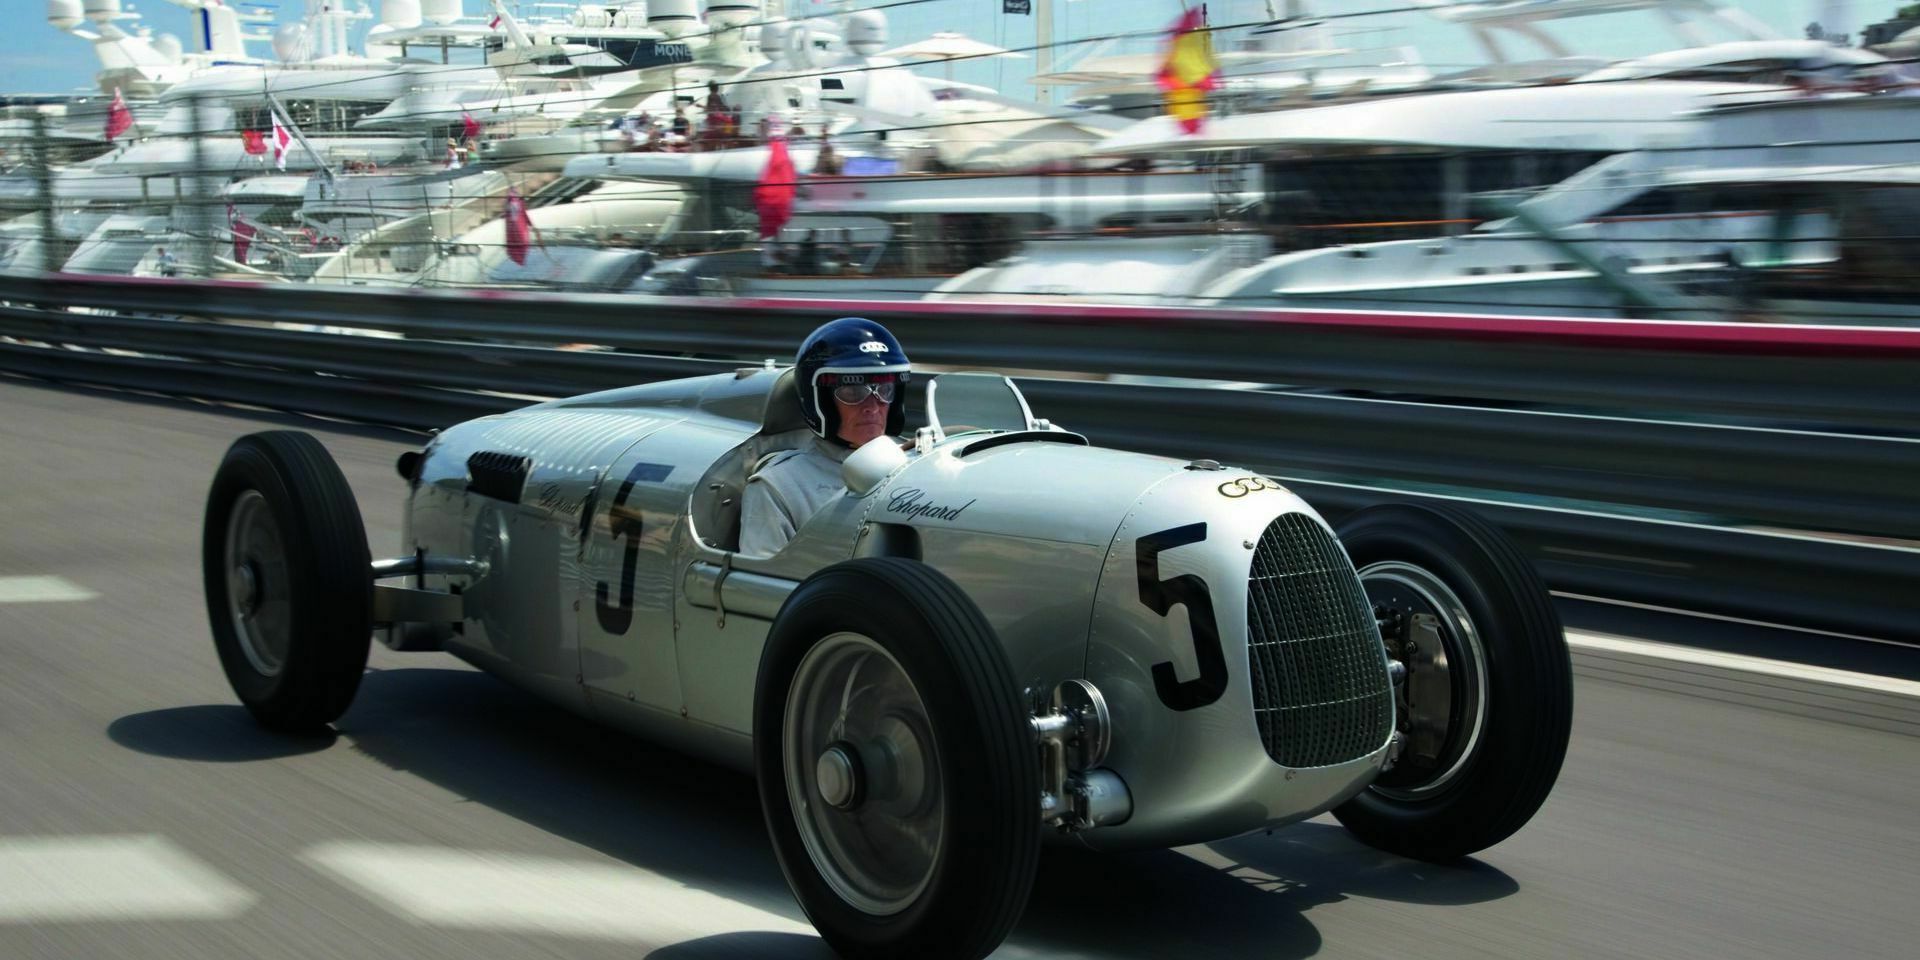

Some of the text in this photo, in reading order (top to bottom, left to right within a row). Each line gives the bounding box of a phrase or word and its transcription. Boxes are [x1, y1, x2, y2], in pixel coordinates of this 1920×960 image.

[595, 462, 676, 636] 5
[886, 486, 977, 522] Chopard
[1135, 521, 1229, 712] 5
